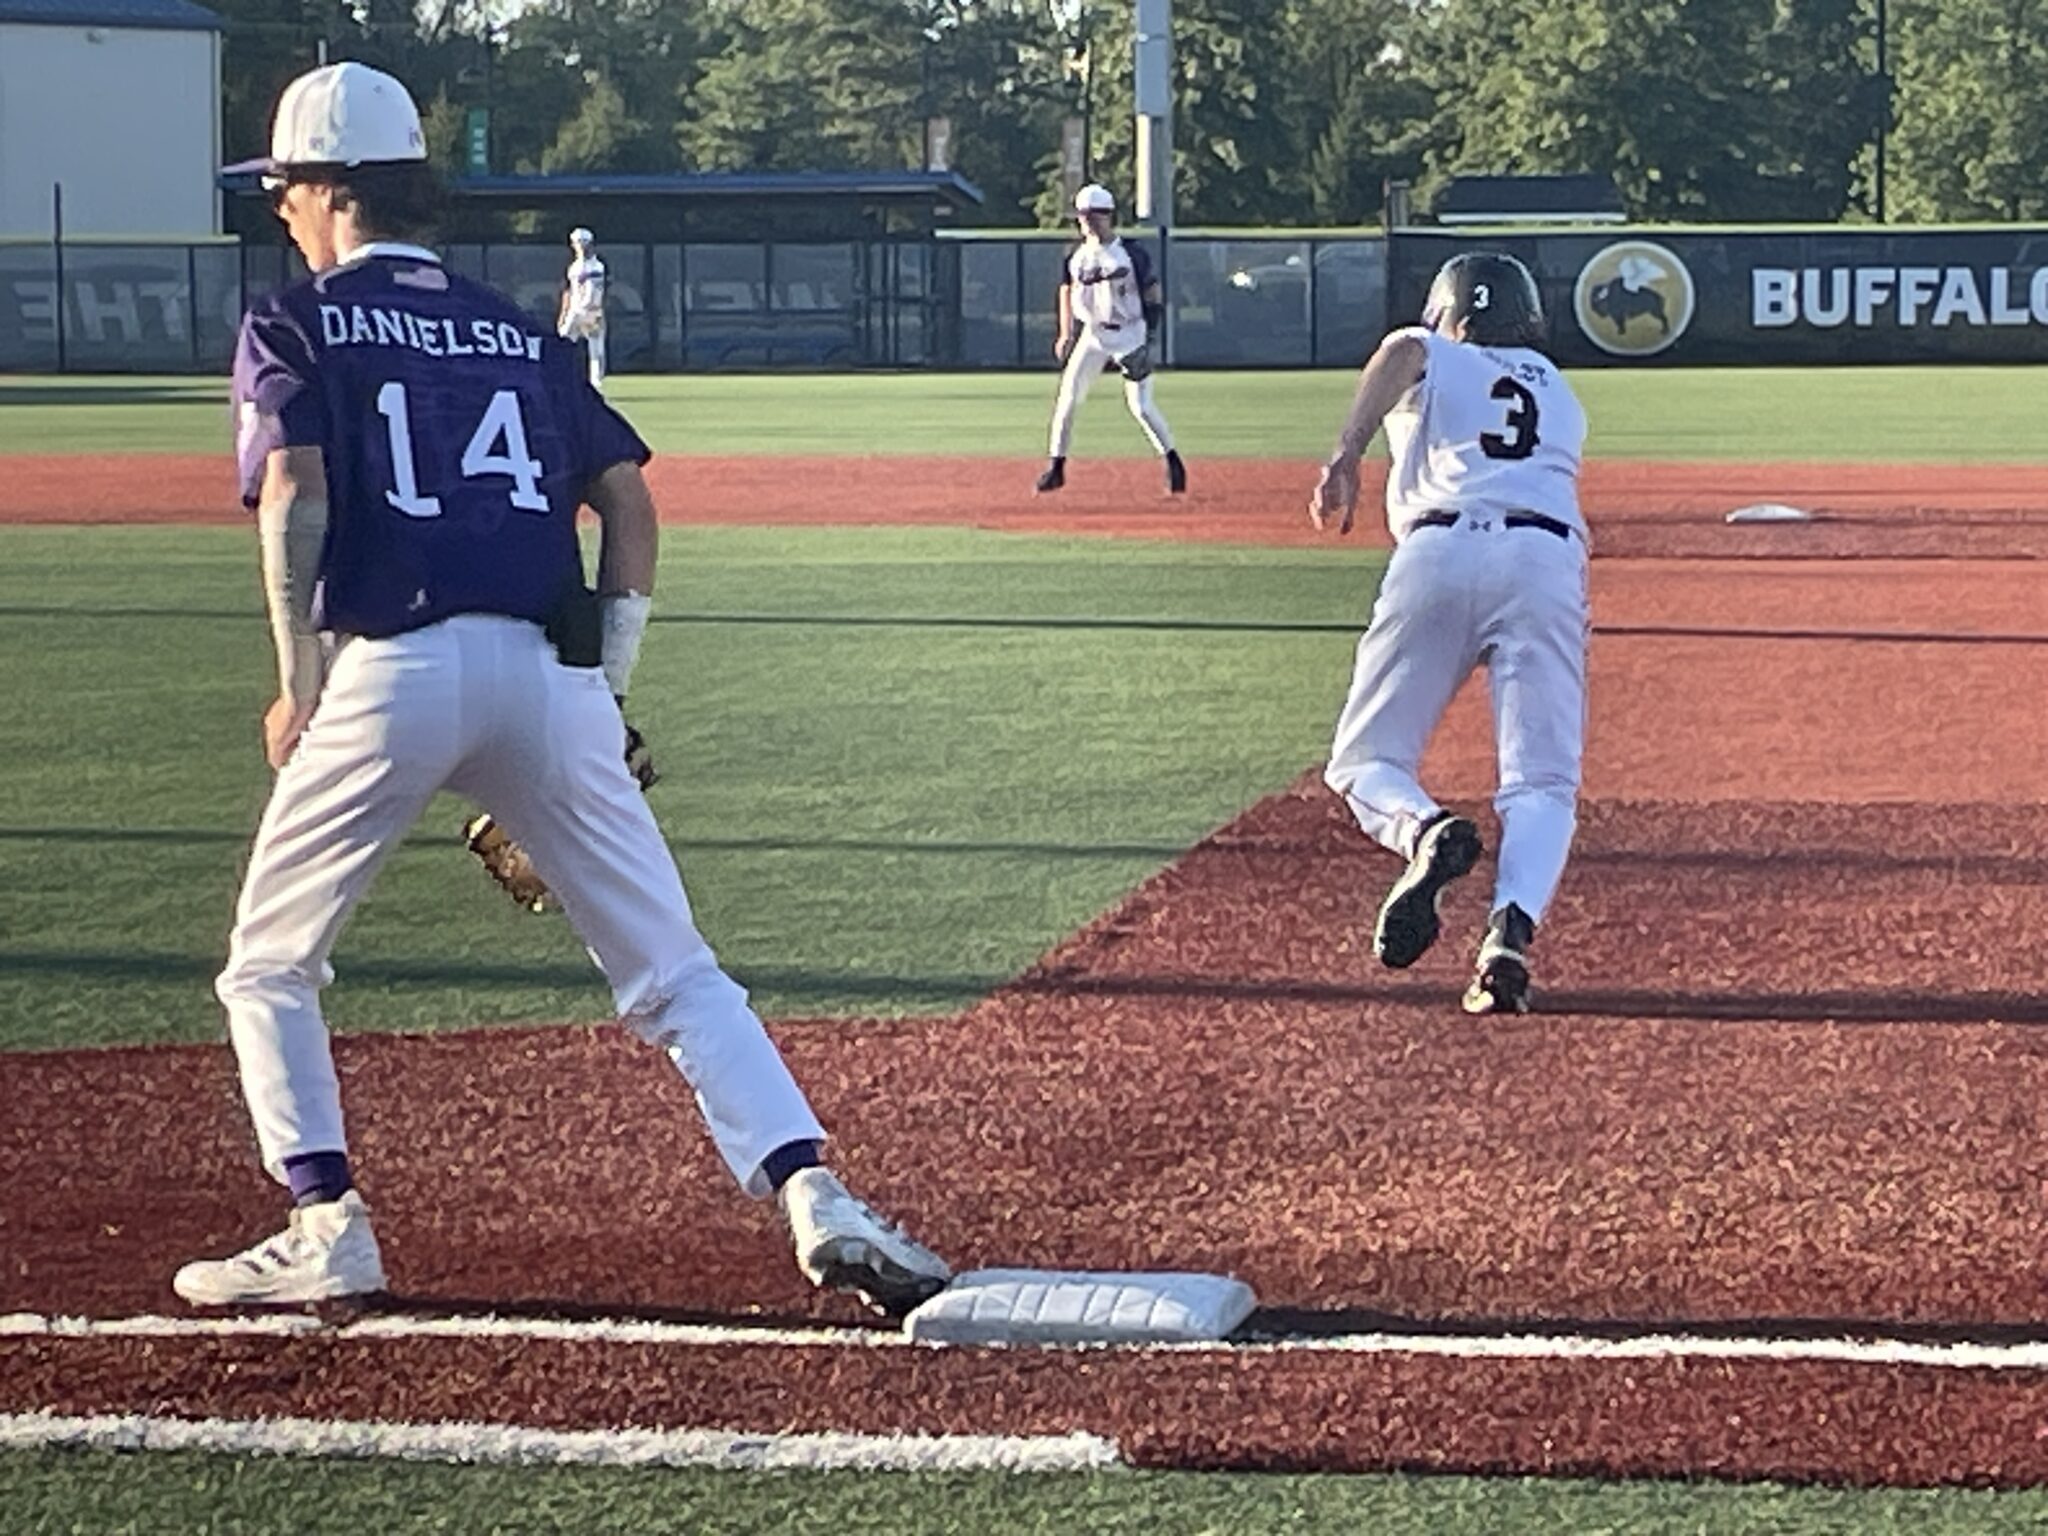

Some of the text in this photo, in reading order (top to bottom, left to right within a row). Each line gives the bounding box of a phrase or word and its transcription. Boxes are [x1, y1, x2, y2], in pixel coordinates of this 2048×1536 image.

[1474, 284, 1490, 309] 3
[378, 382, 550, 516] 14
[1479, 376, 1540, 459] 3
